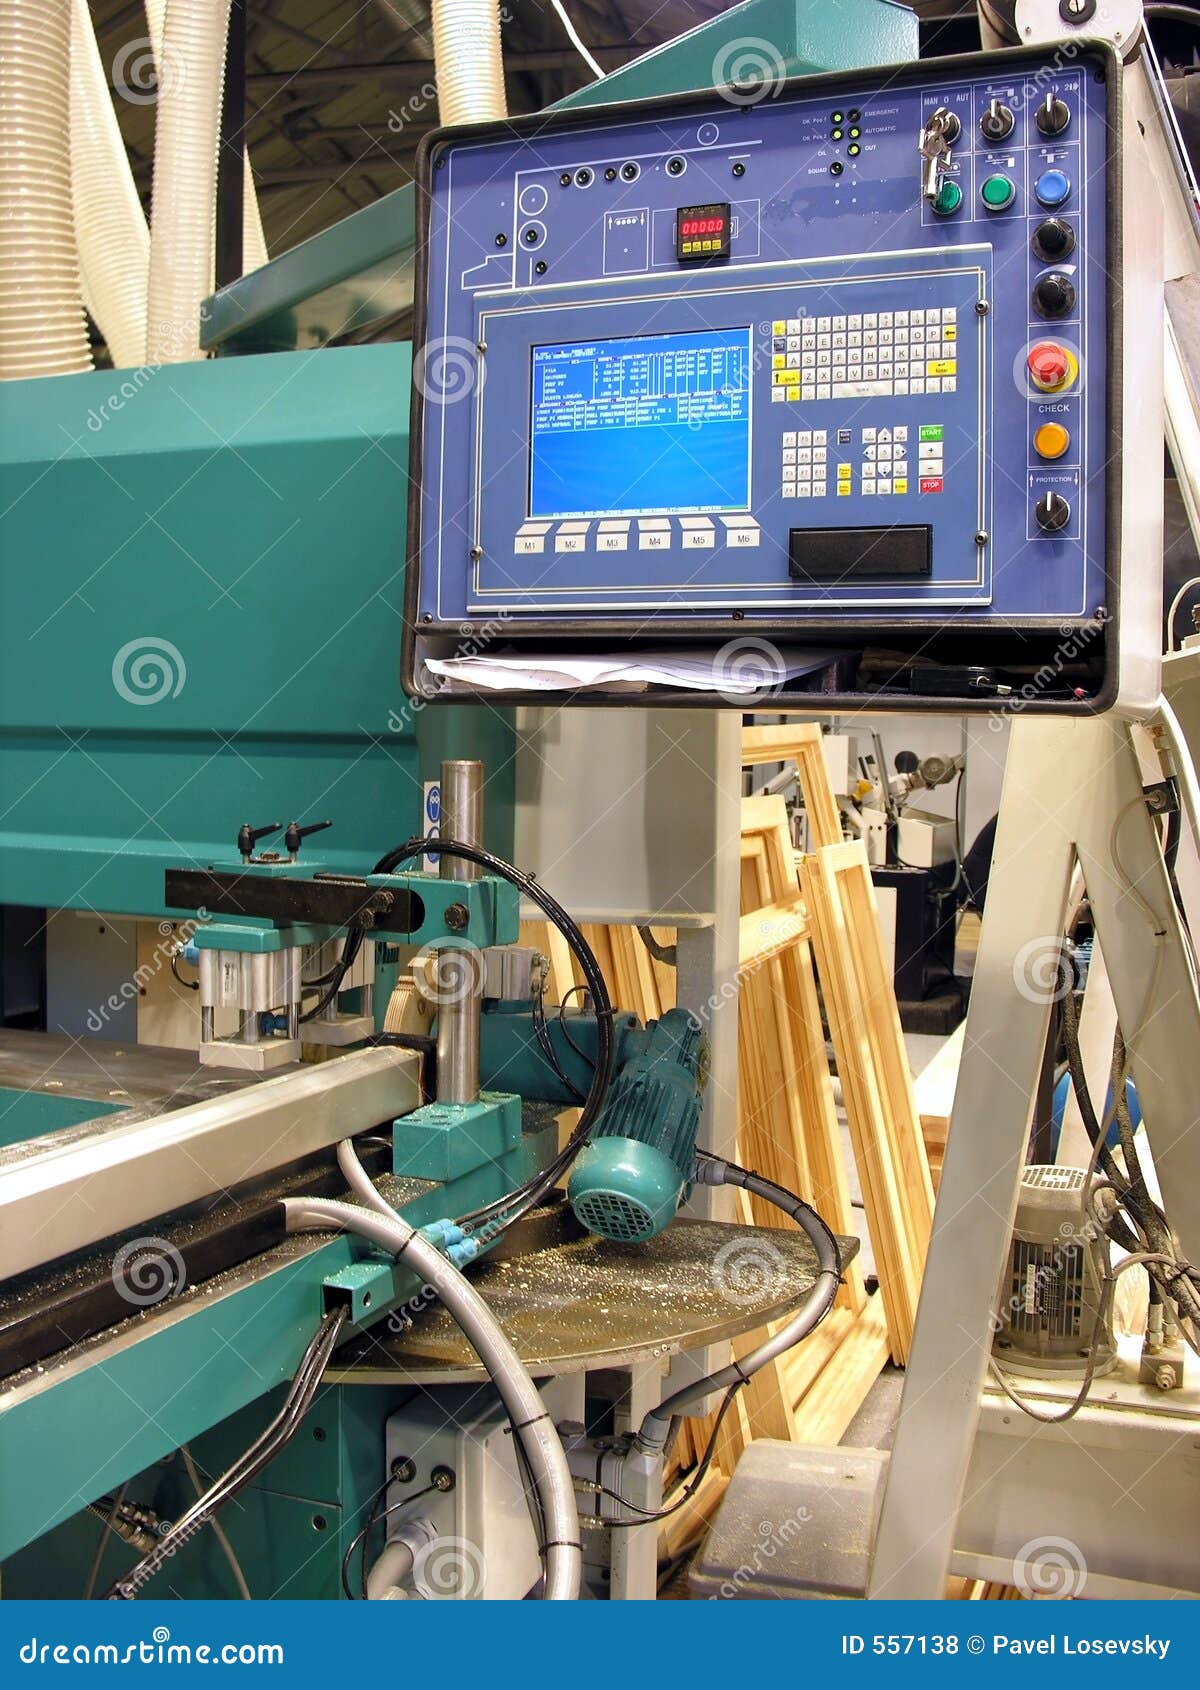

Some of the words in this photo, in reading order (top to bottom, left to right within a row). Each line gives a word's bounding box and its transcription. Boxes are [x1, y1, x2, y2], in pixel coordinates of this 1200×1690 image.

[924, 97, 938, 106] MAN
[956, 93, 969, 102] AUT
[864, 109, 900, 117] EMERGENCY
[865, 126, 897, 134] AUTOMATIC
[807, 167, 827, 175] SQUAD
[1038, 404, 1070, 413] CHECK
[524, 541, 535, 549] M1
[565, 540, 576, 548] M2
[606, 539, 618, 547] M3
[649, 537, 661, 546] M4
[692, 536, 705, 545] M5
[737, 534, 750, 543] M6
